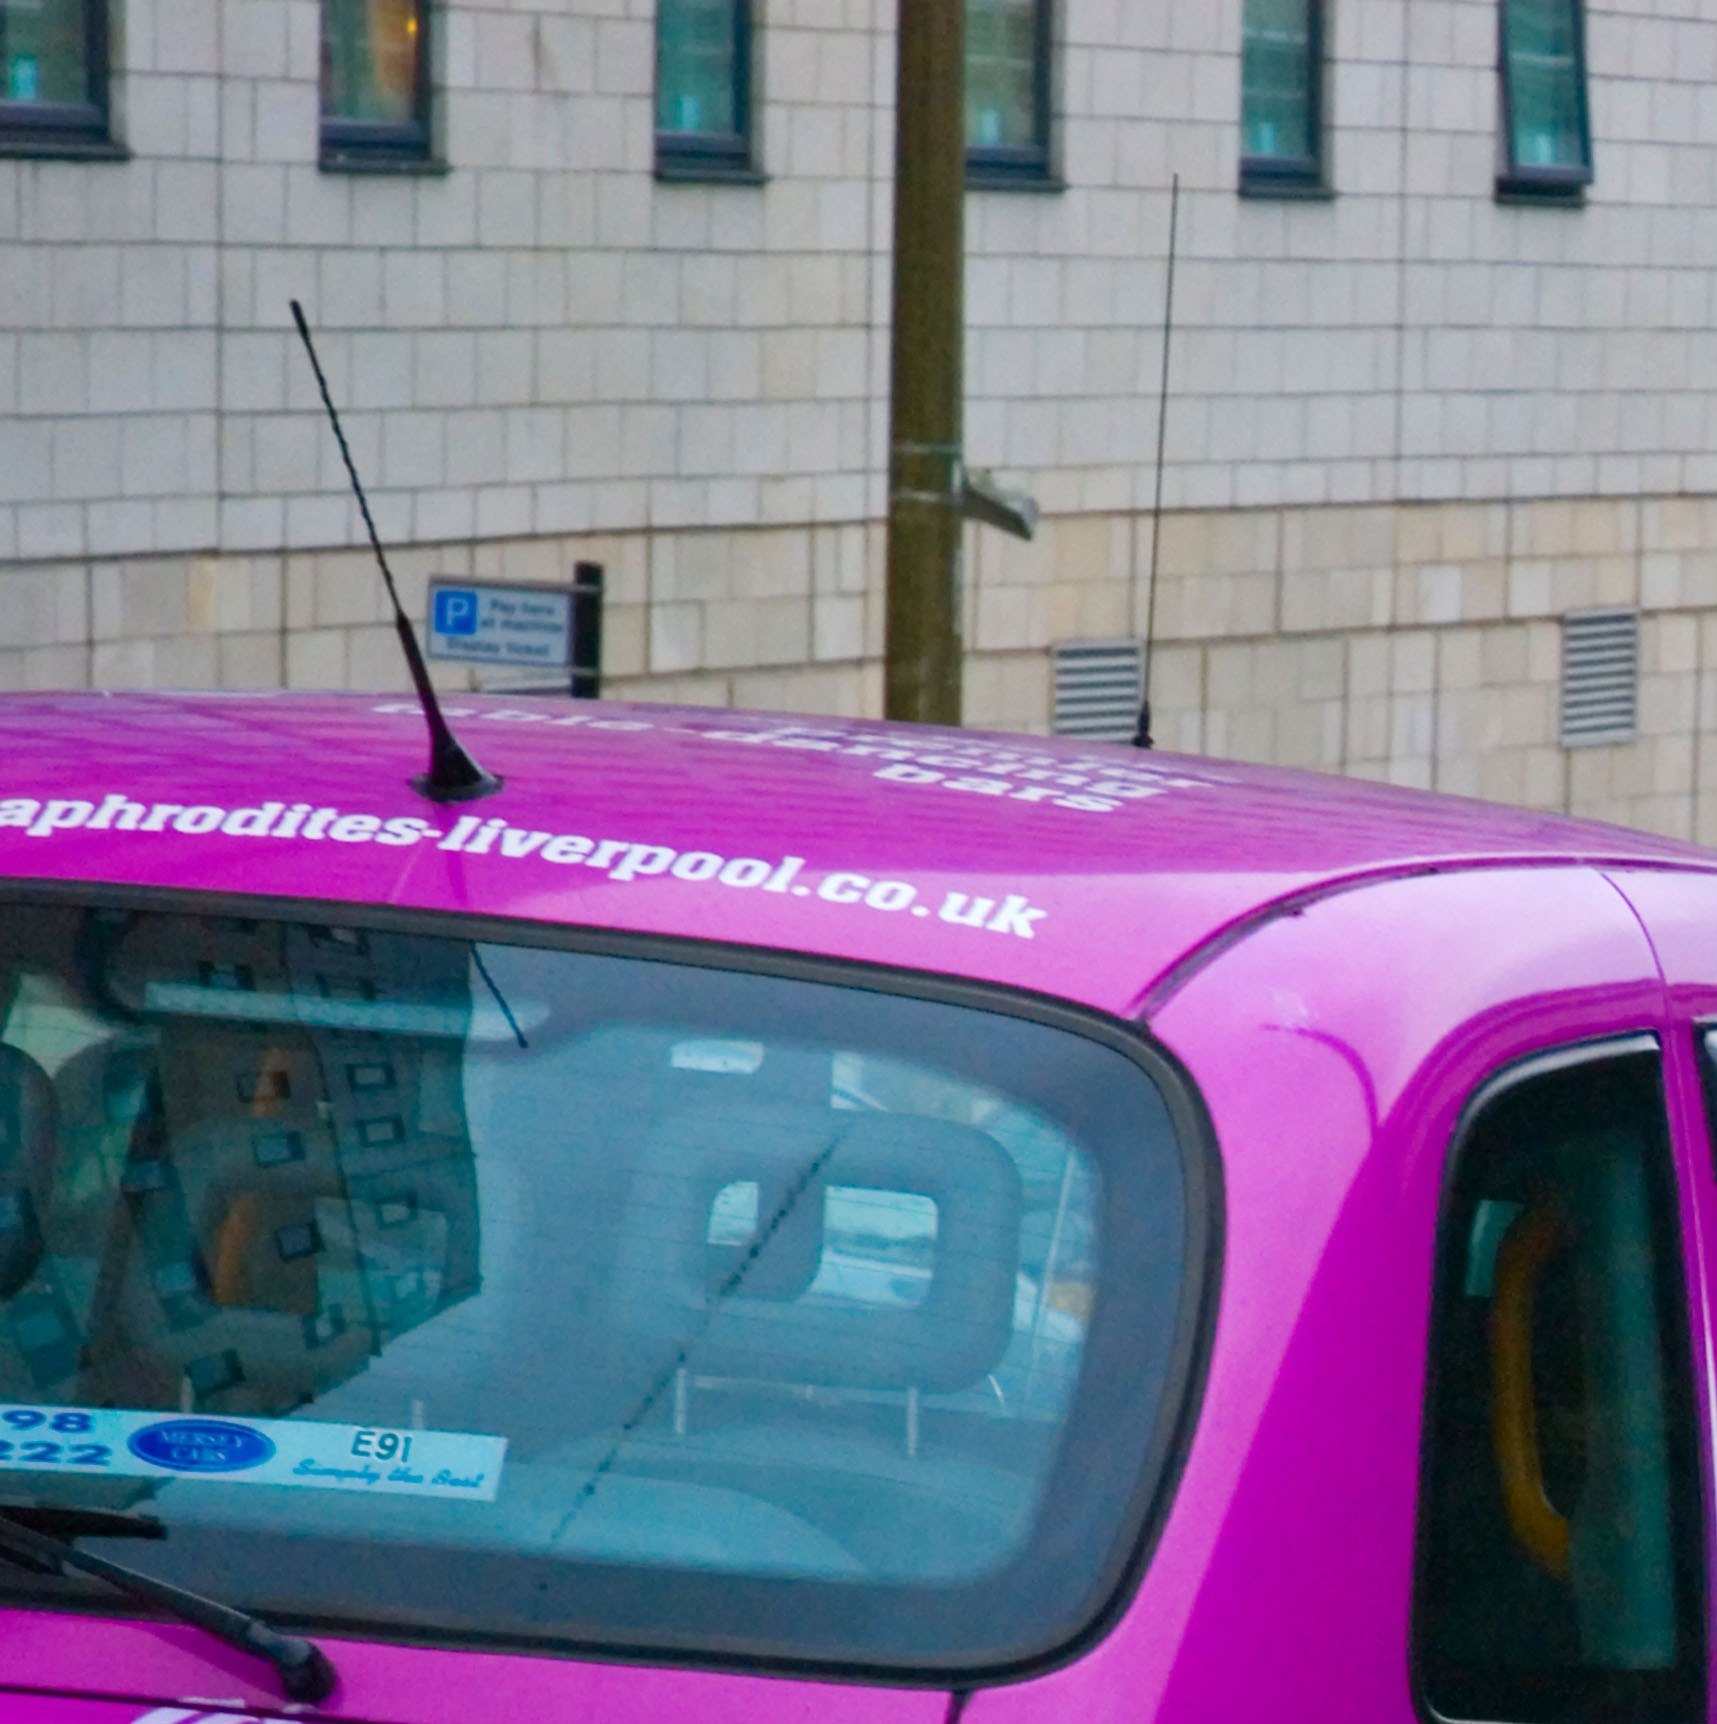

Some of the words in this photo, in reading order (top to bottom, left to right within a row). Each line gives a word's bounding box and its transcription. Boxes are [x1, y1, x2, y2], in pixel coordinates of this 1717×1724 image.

[370, 703, 1170, 799] table-dancing
[872, 763, 1126, 813] bars
[0, 793, 1048, 940] aphrodites-liverpool.co.uk
